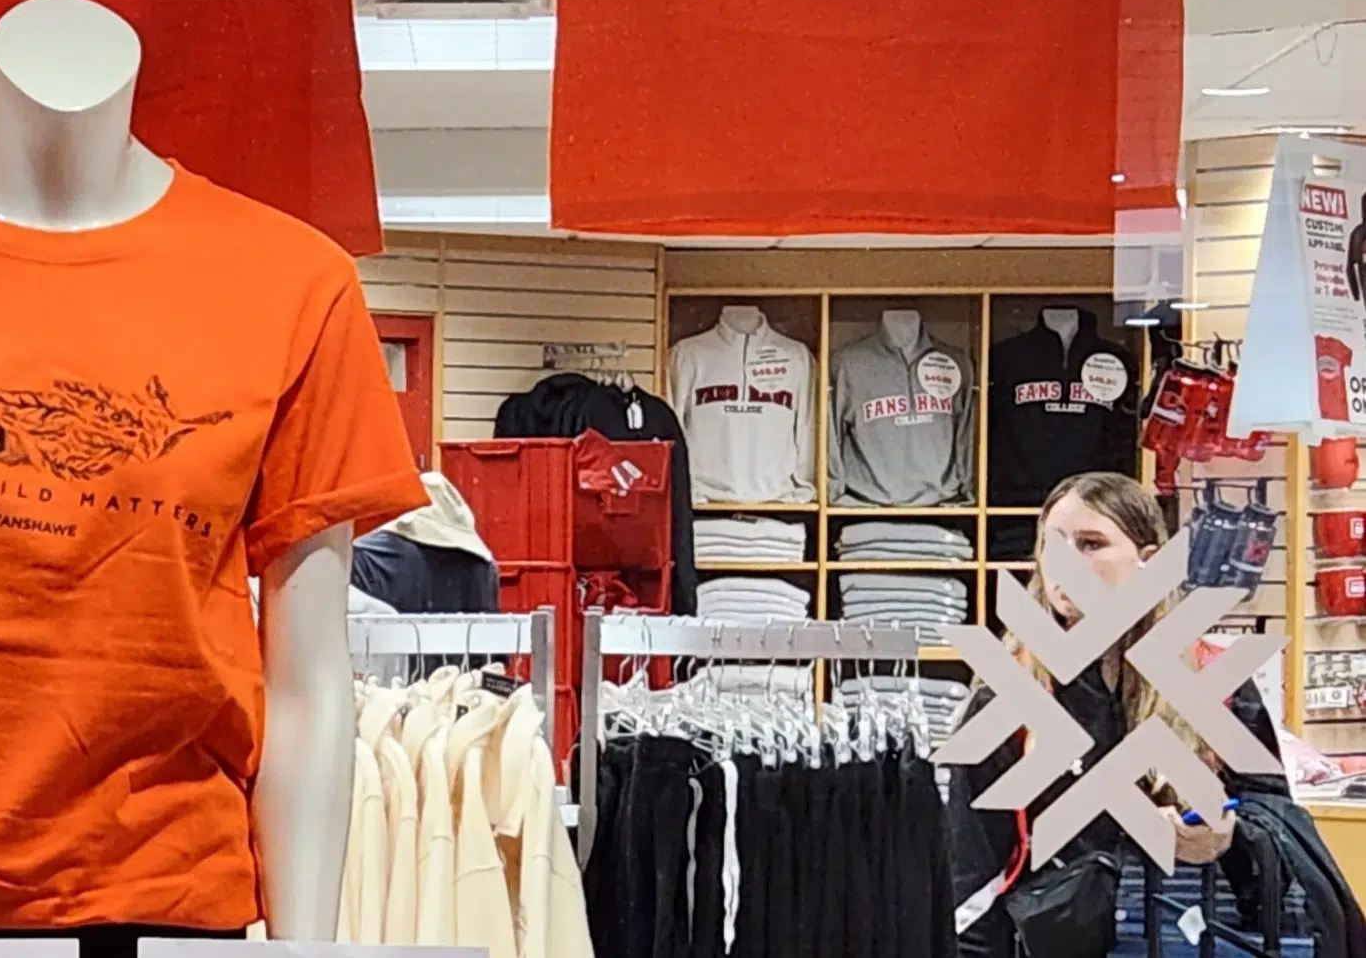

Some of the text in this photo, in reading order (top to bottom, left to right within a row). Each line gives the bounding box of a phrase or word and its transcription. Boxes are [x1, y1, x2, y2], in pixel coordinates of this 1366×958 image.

[1300, 188, 1344, 215] NEW!
[1018, 384, 1060, 402] FANS
[865, 395, 954, 419] FANS HAW
[80, 492, 212, 538] MATTERS
